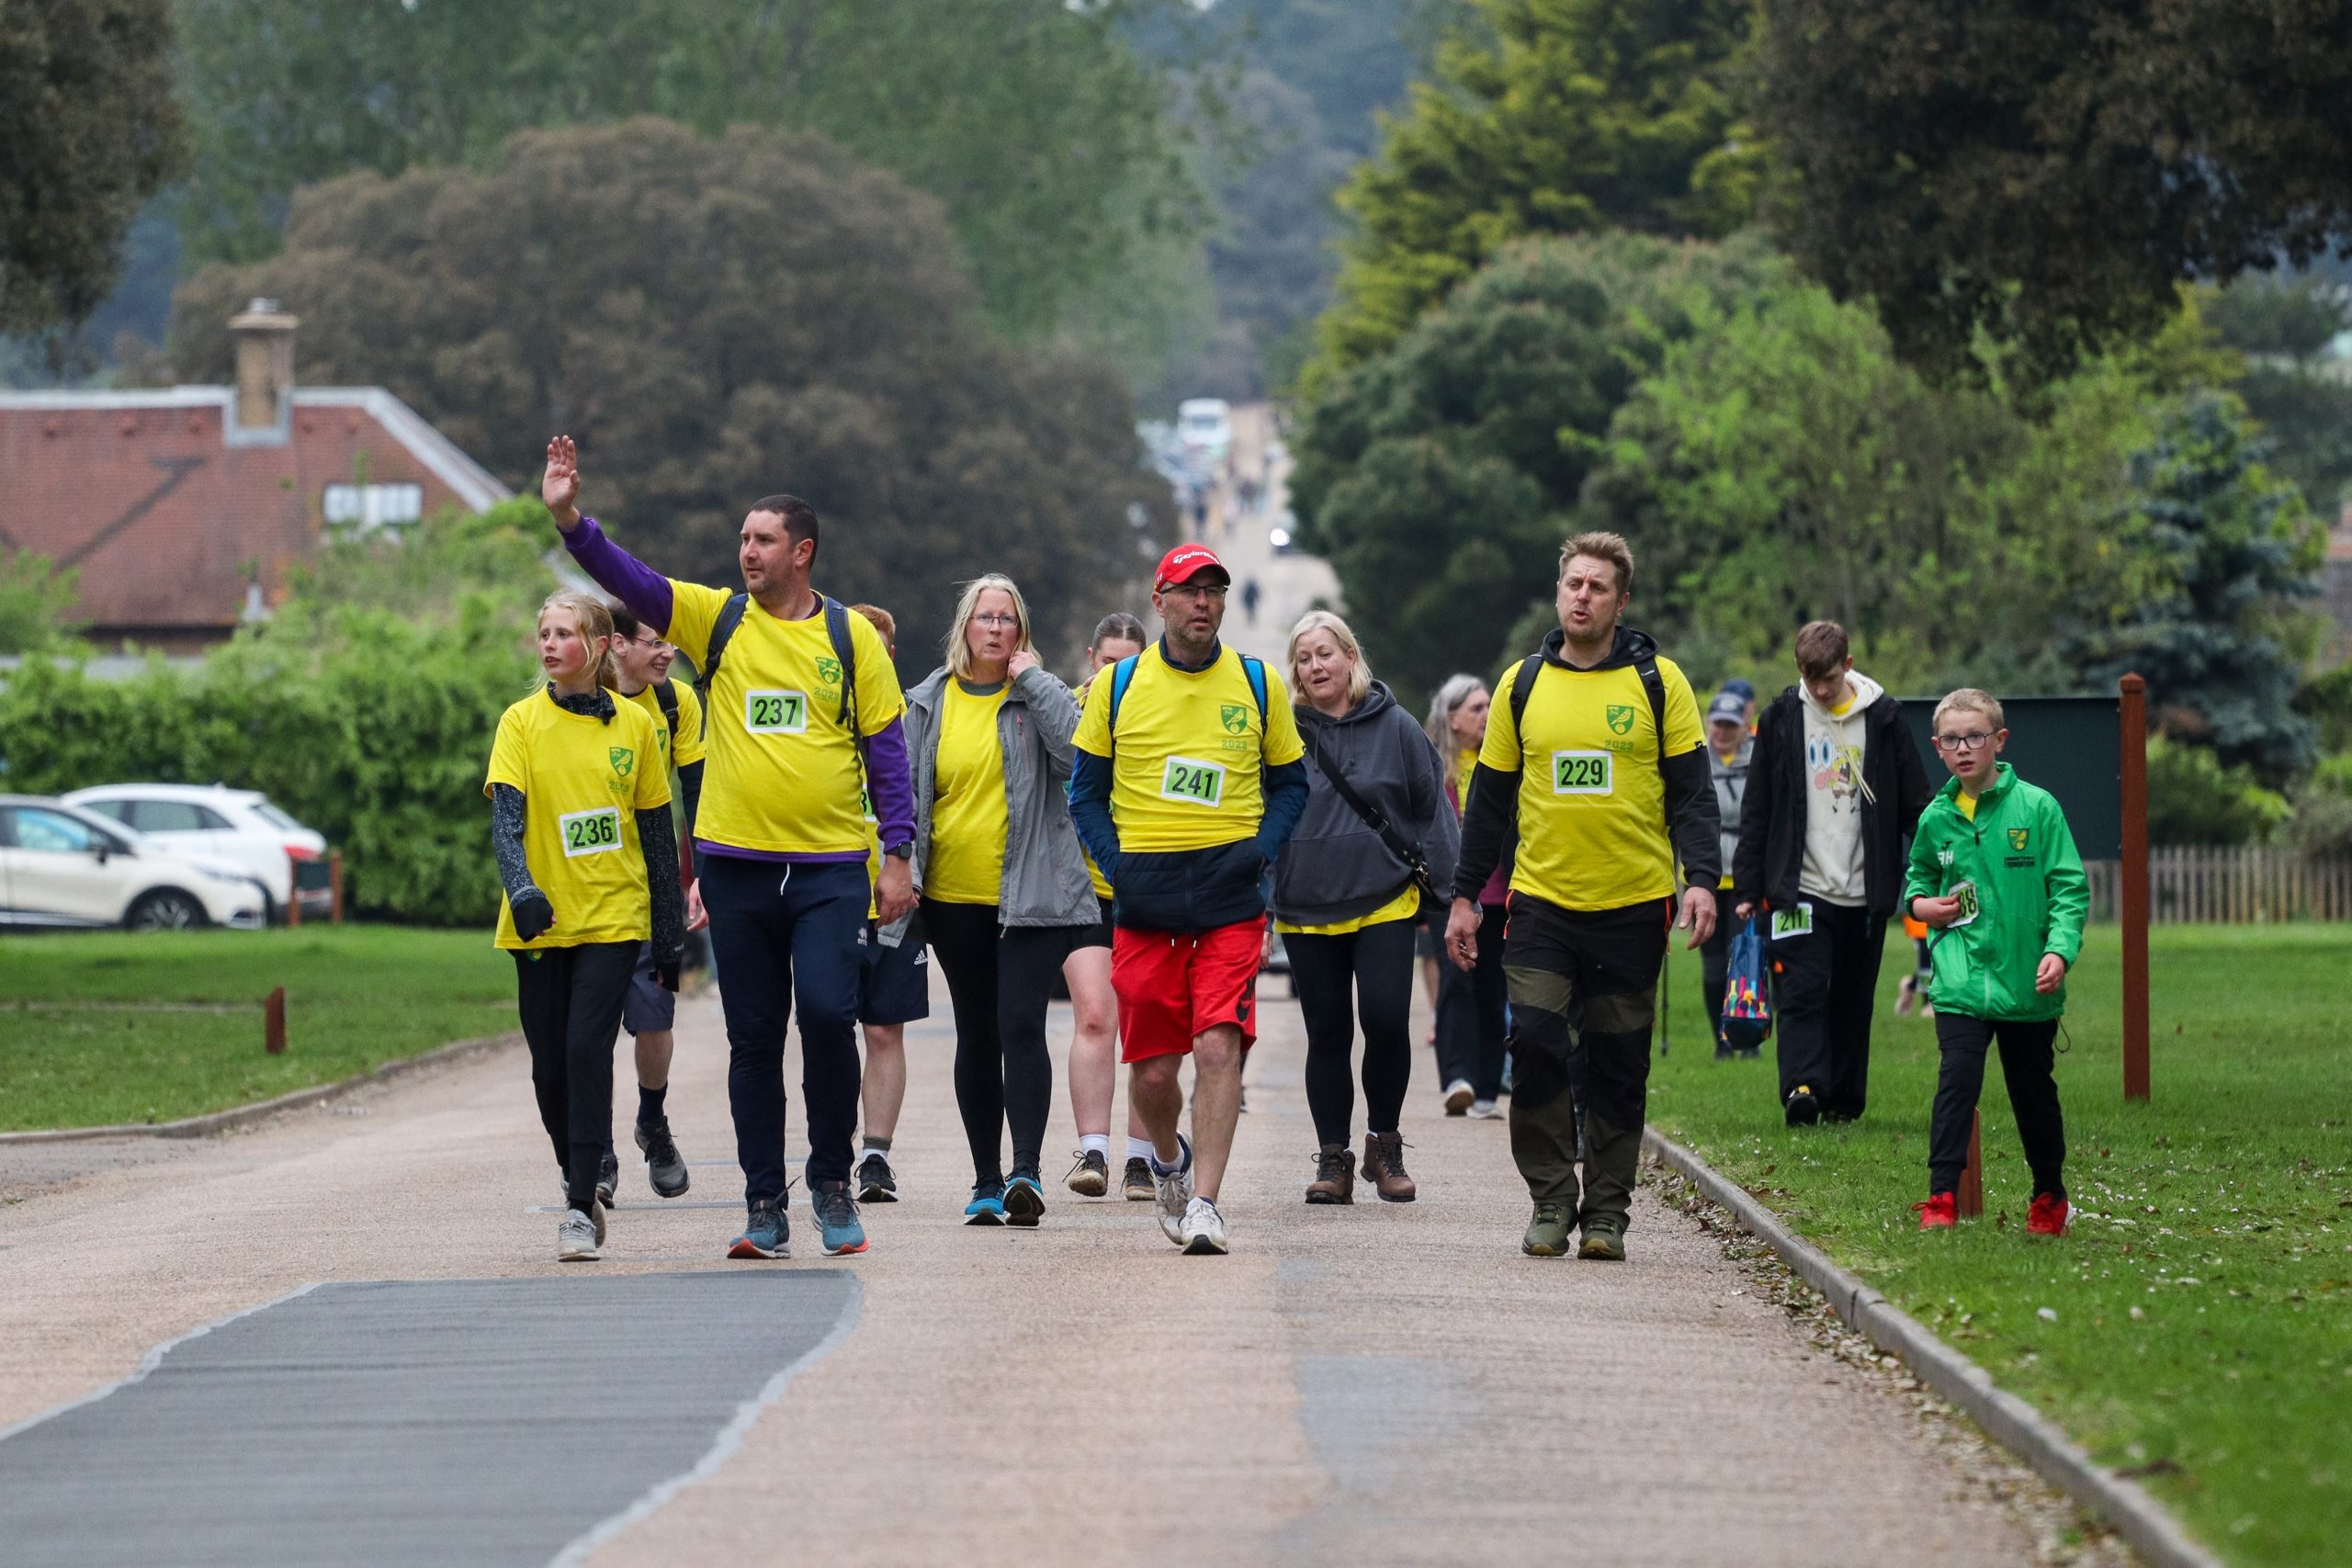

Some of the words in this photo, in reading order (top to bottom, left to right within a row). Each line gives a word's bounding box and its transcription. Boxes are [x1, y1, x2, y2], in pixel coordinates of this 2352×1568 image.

[754, 698, 797, 725] 237
[1221, 739, 1248, 750] 2023
[1604, 739, 1634, 750] 2023
[1172, 766, 1214, 797] 241
[1561, 759, 1603, 785] 229
[570, 816, 613, 847] 236
[1781, 908, 1802, 931] 211
